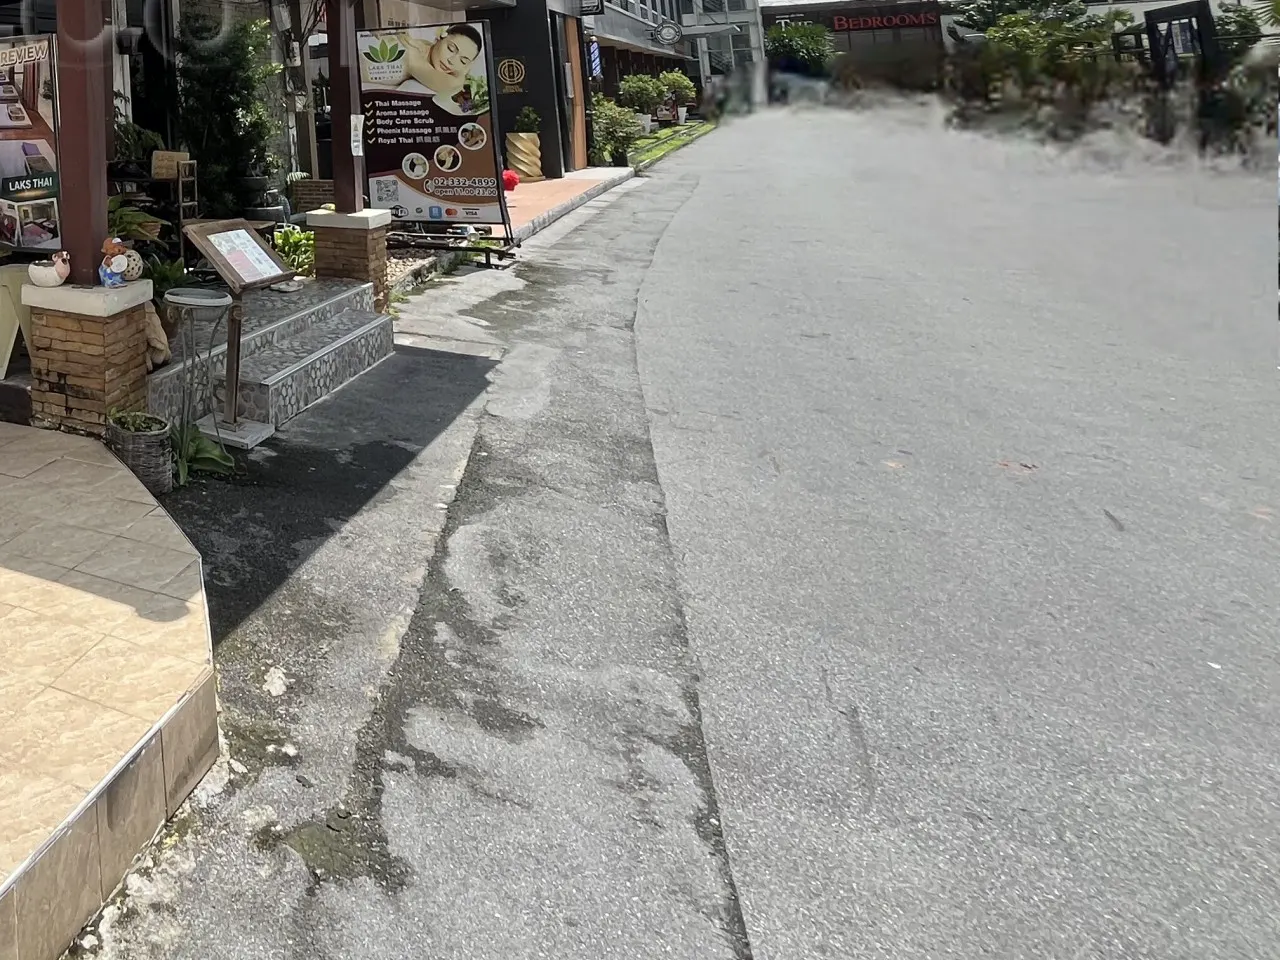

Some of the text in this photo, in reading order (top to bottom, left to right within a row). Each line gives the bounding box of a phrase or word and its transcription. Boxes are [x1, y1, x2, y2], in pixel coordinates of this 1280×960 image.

[833, 13, 937, 31] BEDROOMS
[0, 41, 49, 67] REVIEW
[9, 176, 53, 191] LAKS THAI
[433, 177, 497, 187] 02-332-4899
